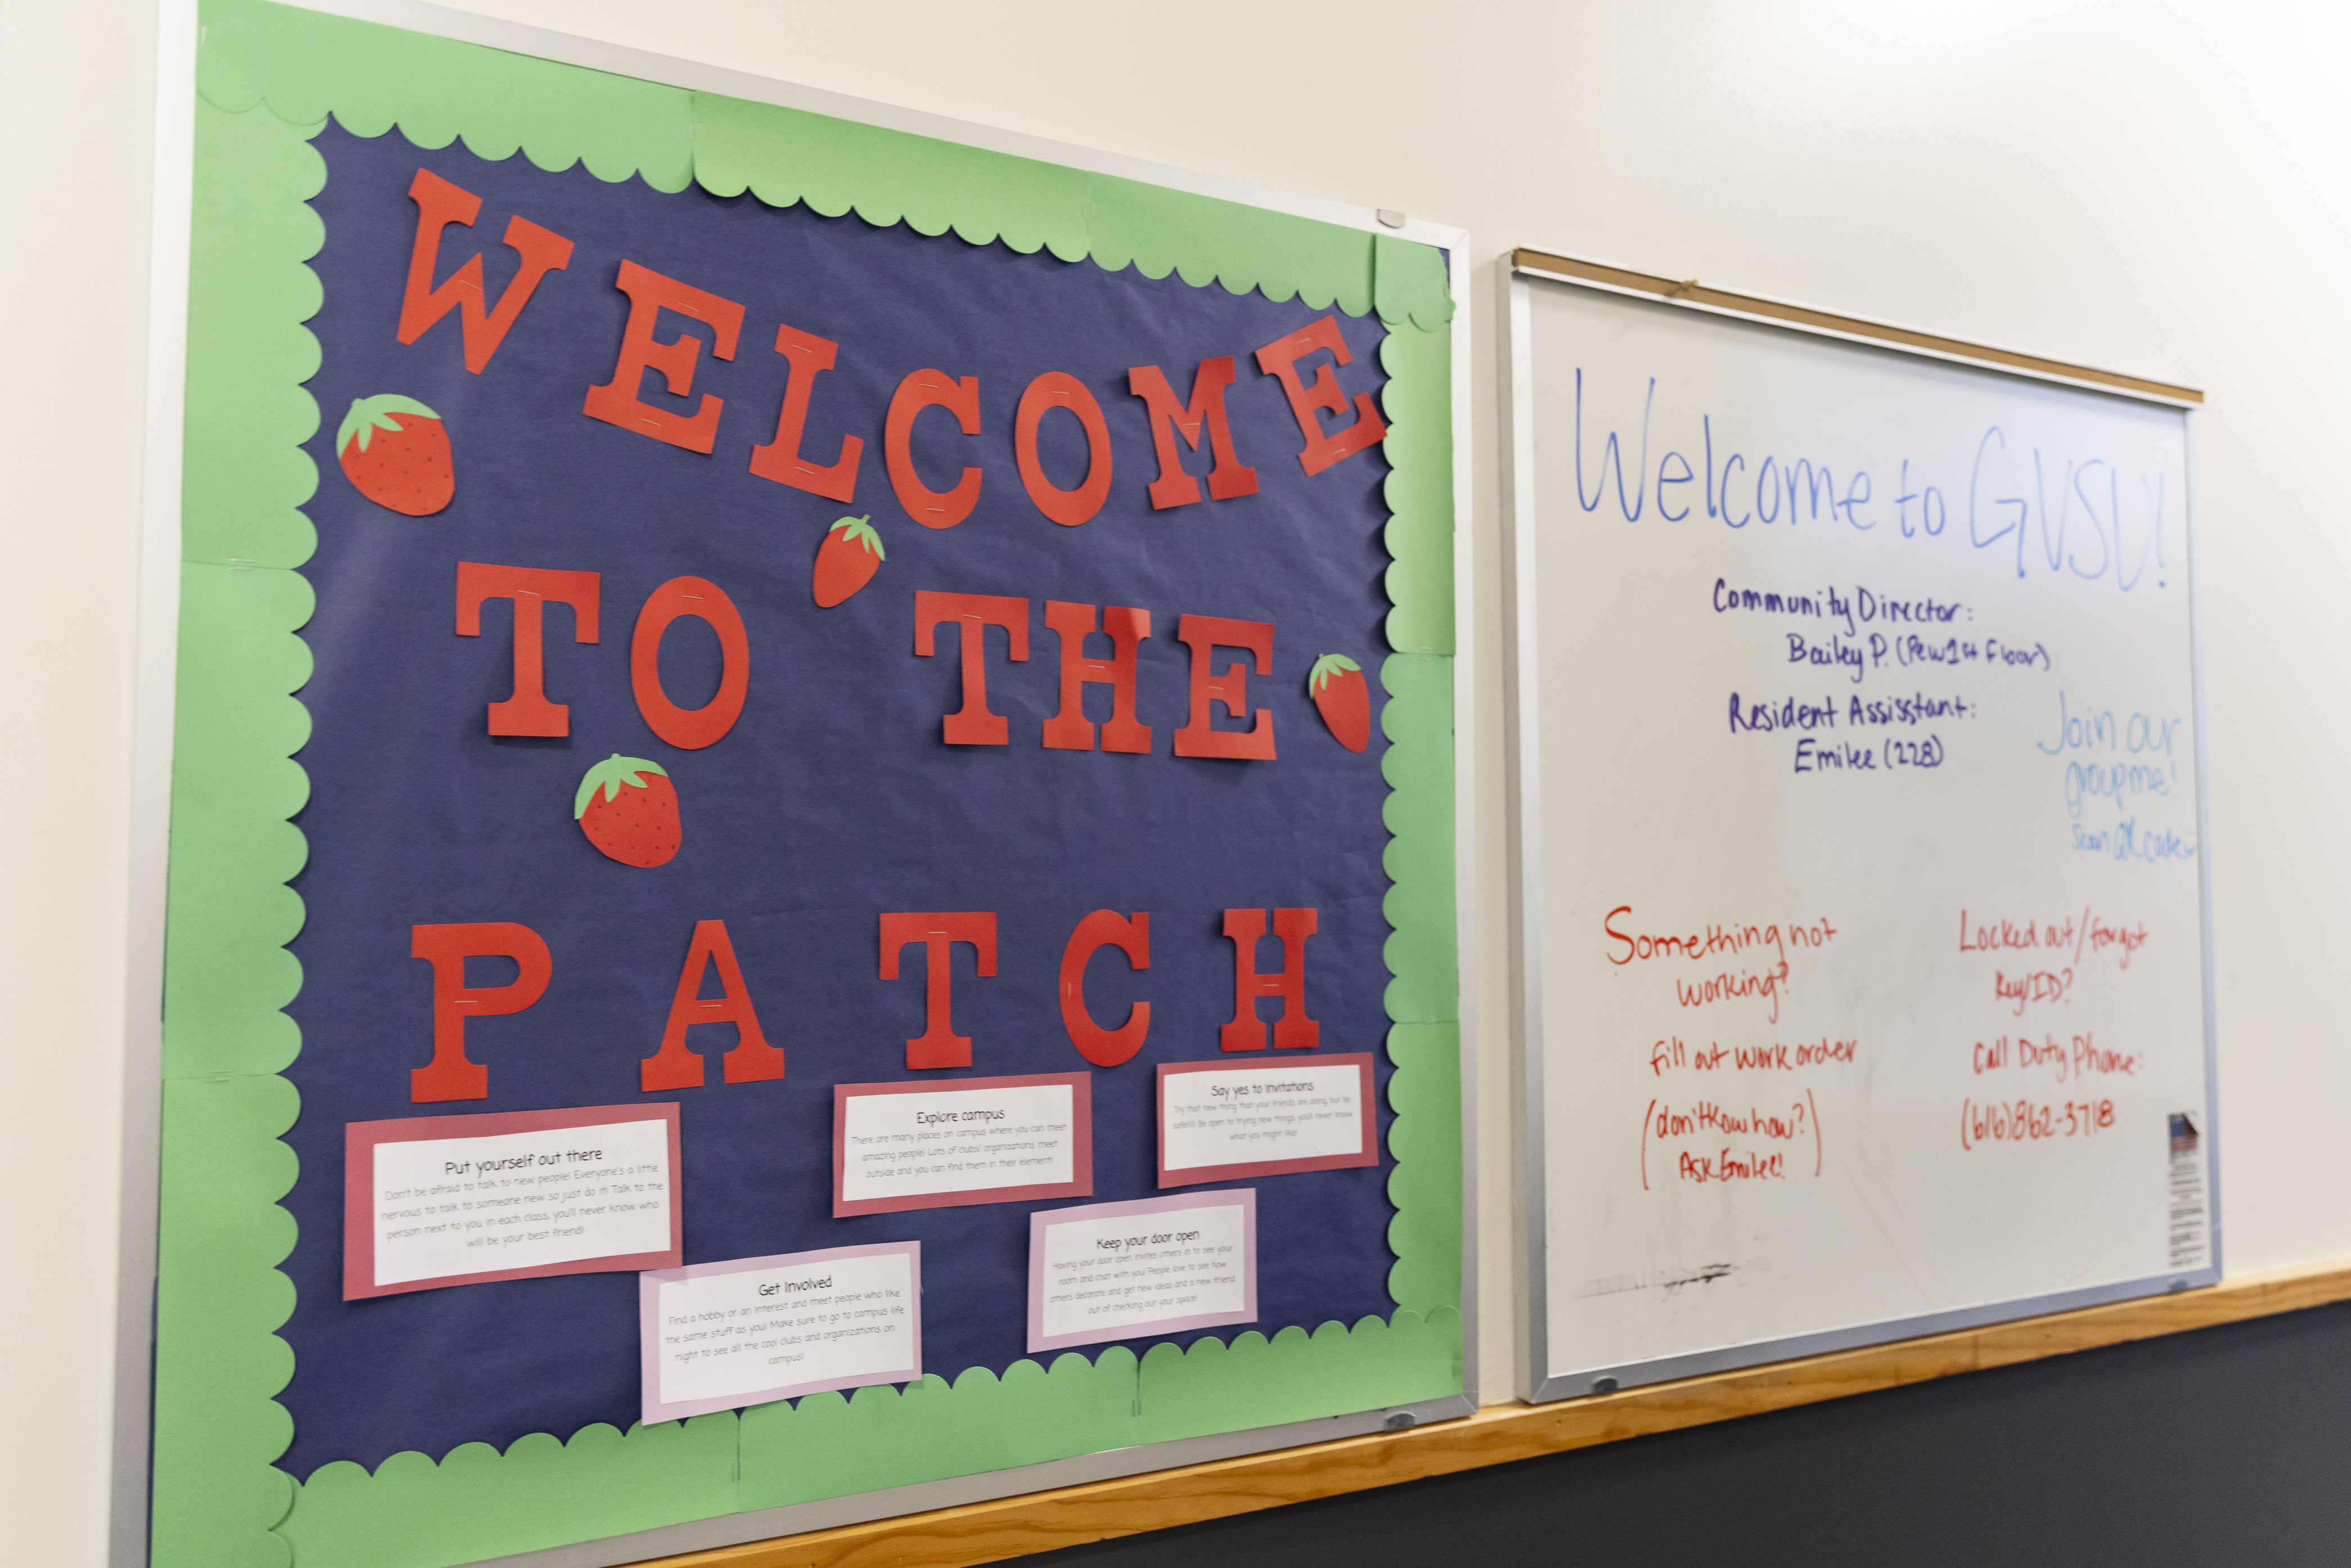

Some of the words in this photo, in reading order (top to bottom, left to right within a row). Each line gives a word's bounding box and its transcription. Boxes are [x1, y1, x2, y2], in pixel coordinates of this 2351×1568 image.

[397, 168, 1388, 528] WELCOME
[1575, 367, 1877, 529] Welcome
[1894, 458, 1945, 538] to
[1969, 425, 2167, 592] GVSU!
[1713, 577, 1856, 637] Community
[1855, 585, 1974, 622] Director:
[455, 562, 749, 750] TO
[915, 589, 1277, 760] THE
[1786, 633, 1864, 683] Bailey
[1869, 632, 1889, 667] P.
[1729, 692, 1838, 732] Resident
[2037, 690, 2116, 755] Join
[2127, 711, 2182, 756] our
[1884, 733, 1943, 769] (228)
[1605, 905, 1784, 965] Something
[1790, 917, 1837, 947] not
[1960, 908, 2039, 953] Locked
[410, 907, 1320, 1103] PATCH
[1650, 1036, 1686, 1077] fill
[1695, 1042, 1730, 1070] out
[1735, 1044, 1792, 1071] work
[1796, 1038, 1857, 1066] order
[1973, 1035, 2008, 1075] Call
[2019, 1033, 2068, 1084] Duty
[2073, 1031, 2144, 1077] Phone:
[1211, 1085, 1229, 1101] Say
[1232, 1085, 1249, 1100] yes
[1252, 1084, 1262, 1093] to
[916, 1111, 958, 1128] Explore
[961, 1110, 1005, 1124] campus
[430, 1183, 460, 1195] afraid
[477, 1179, 497, 1189] talk
[637, 1164, 659, 1173] little
[445, 1161, 471, 1174] Put
[475, 1154, 535, 1178] yourself
[538, 1151, 561, 1165] out
[565, 1150, 602, 1162] there
[1679, 1151, 1720, 1183] Ask
[381, 1208, 421, 1219] nervous
[439, 1202, 459, 1212] talk
[476, 1197, 521, 1209] someone
[548, 1192, 559, 1201] so
[560, 1189, 580, 1203] just
[584, 1188, 596, 1196] do
[610, 1184, 632, 1193] Talk
[386, 1227, 421, 1241] person
[424, 1223, 447, 1233] next
[464, 1220, 482, 1232] you
[498, 1215, 521, 1224] each
[579, 1206, 606, 1215] never
[638, 1201, 659, 1209] who
[487, 1237, 498, 1245] be
[502, 1234, 524, 1247] your
[527, 1230, 549, 1240] best
[1096, 1238, 1122, 1252] Keep
[1124, 1236, 1148, 1252] your
[1150, 1233, 1173, 1243] door
[1176, 1231, 1199, 1245] open
[668, 1315, 687, 1324] Find
[698, 1311, 725, 1322] hobby
[754, 1301, 789, 1313] interest
[791, 1299, 807, 1308] and
[809, 1296, 832, 1305] meet
[834, 1292, 862, 1306] people
[758, 1282, 781, 1296] Get
[683, 1332, 708, 1342] same
[710, 1326, 734, 1337] stuff
[769, 1319, 794, 1328] Make
[796, 1317, 815, 1326] sure
[829, 1313, 840, 1324] go
[854, 1308, 888, 1319] campus
[890, 1305, 904, 1314] life
[675, 1350, 698, 1363] night
[713, 1347, 728, 1355] see
[731, 1343, 741, 1353] all
[761, 1338, 777, 1348] cool
[780, 1336, 802, 1345] clubs
[804, 1332, 821, 1341] and
[823, 1326, 881, 1341] organizations
